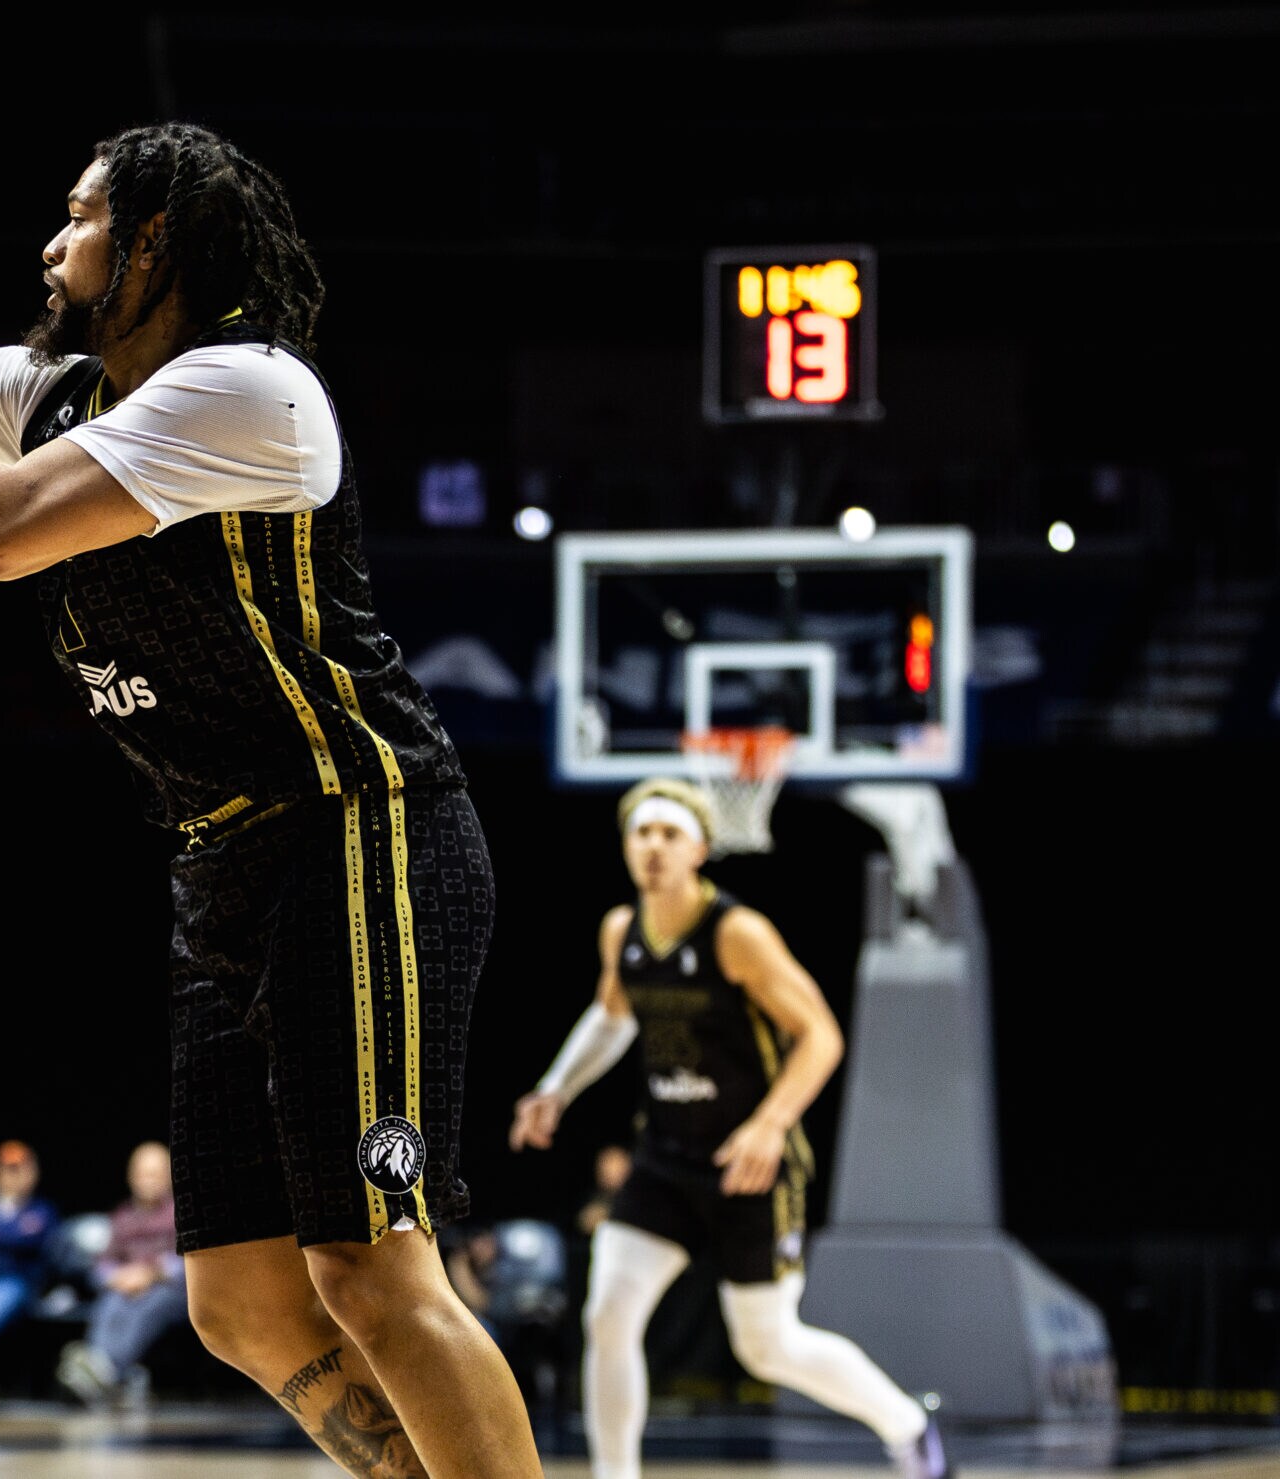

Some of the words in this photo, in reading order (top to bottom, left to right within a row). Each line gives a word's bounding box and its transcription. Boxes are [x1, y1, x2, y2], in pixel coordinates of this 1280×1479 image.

[768, 311, 848, 403] 13
[299, 512, 310, 586] BOARDROOM
[304, 594, 315, 641] PILLAR
[89, 675, 158, 718] AUS
[308, 720, 328, 766] PILLAR
[350, 845, 359, 894] PILLAR
[394, 807, 402, 837] ROOM
[400, 901, 410, 946] LIVING
[406, 954, 414, 985] ROOM
[354, 912, 367, 990] BOARDROOM
[379, 921, 392, 1001] CLASSROOM
[361, 1000, 369, 1053] PILLAR
[363, 1071, 372, 1130] BOARDR
[361, 1120, 390, 1169] MINNESOTA
[394, 1119, 425, 1179] TIMBERWOLVES
